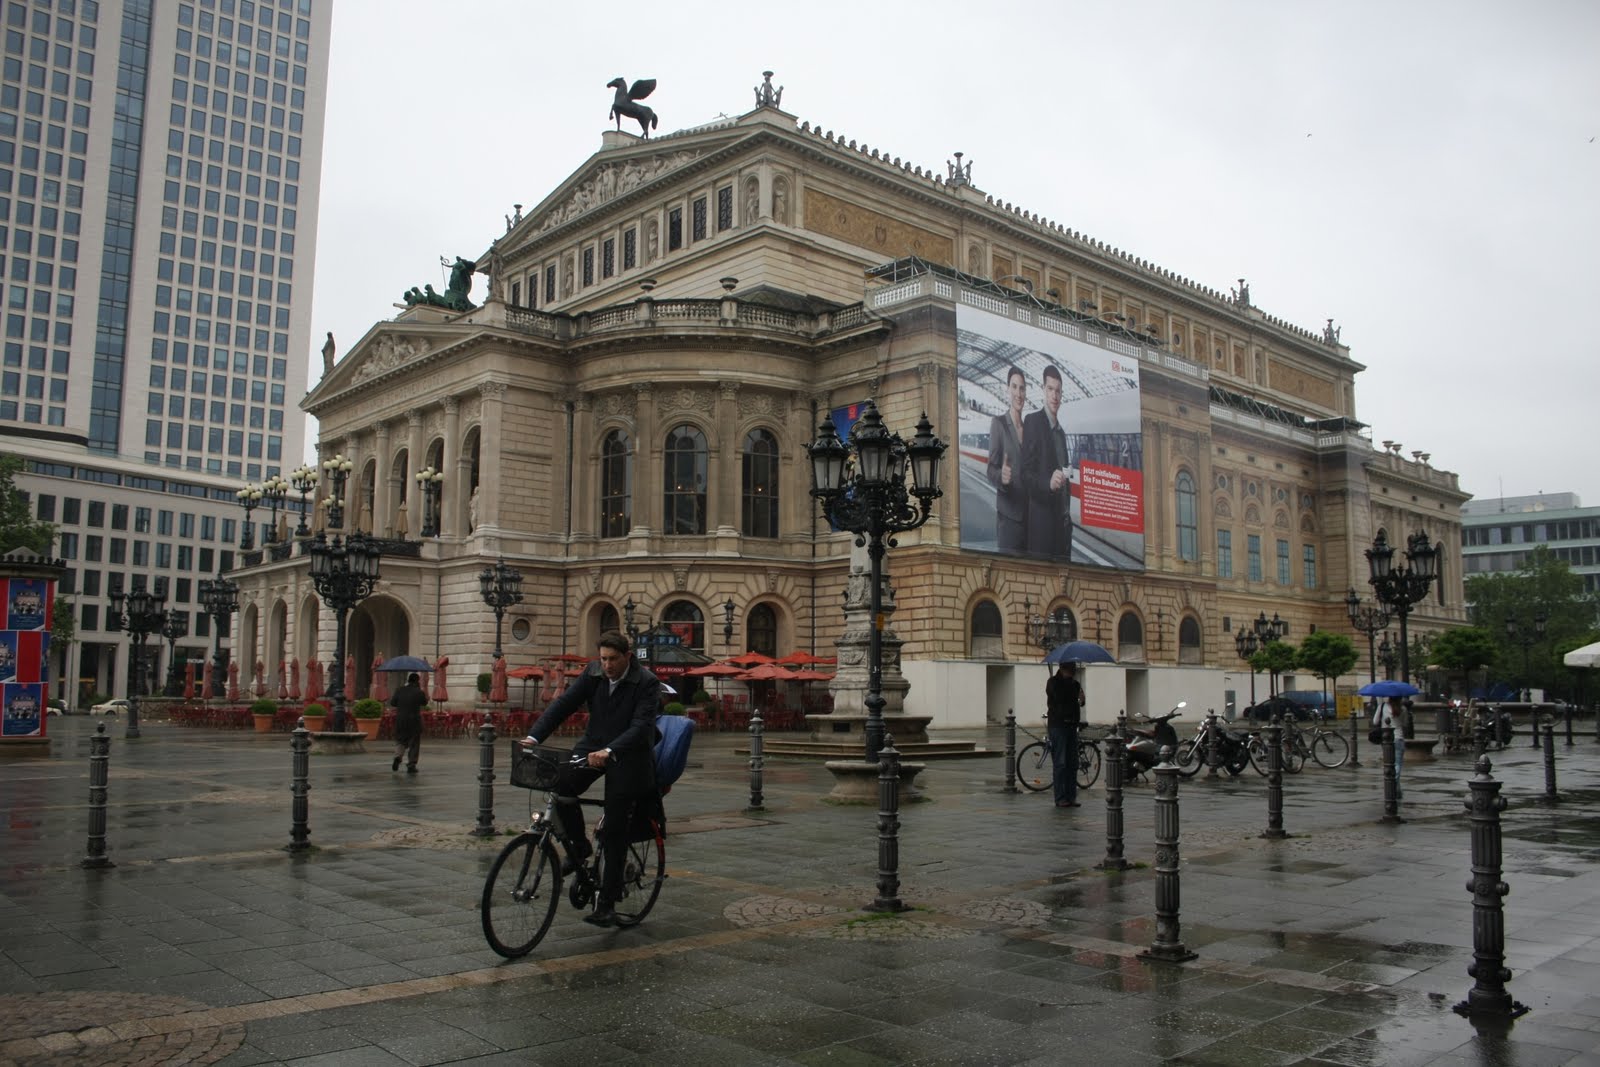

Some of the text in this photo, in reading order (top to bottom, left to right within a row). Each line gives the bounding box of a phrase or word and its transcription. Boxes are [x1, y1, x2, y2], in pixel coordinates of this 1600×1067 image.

[1121, 440, 1129, 457] 2
[1083, 466, 1095, 475] Jetzt
[1083, 475, 1092, 483] Die
[1092, 476, 1101, 485] Fan
[1101, 478, 1124, 490] BahnCard
